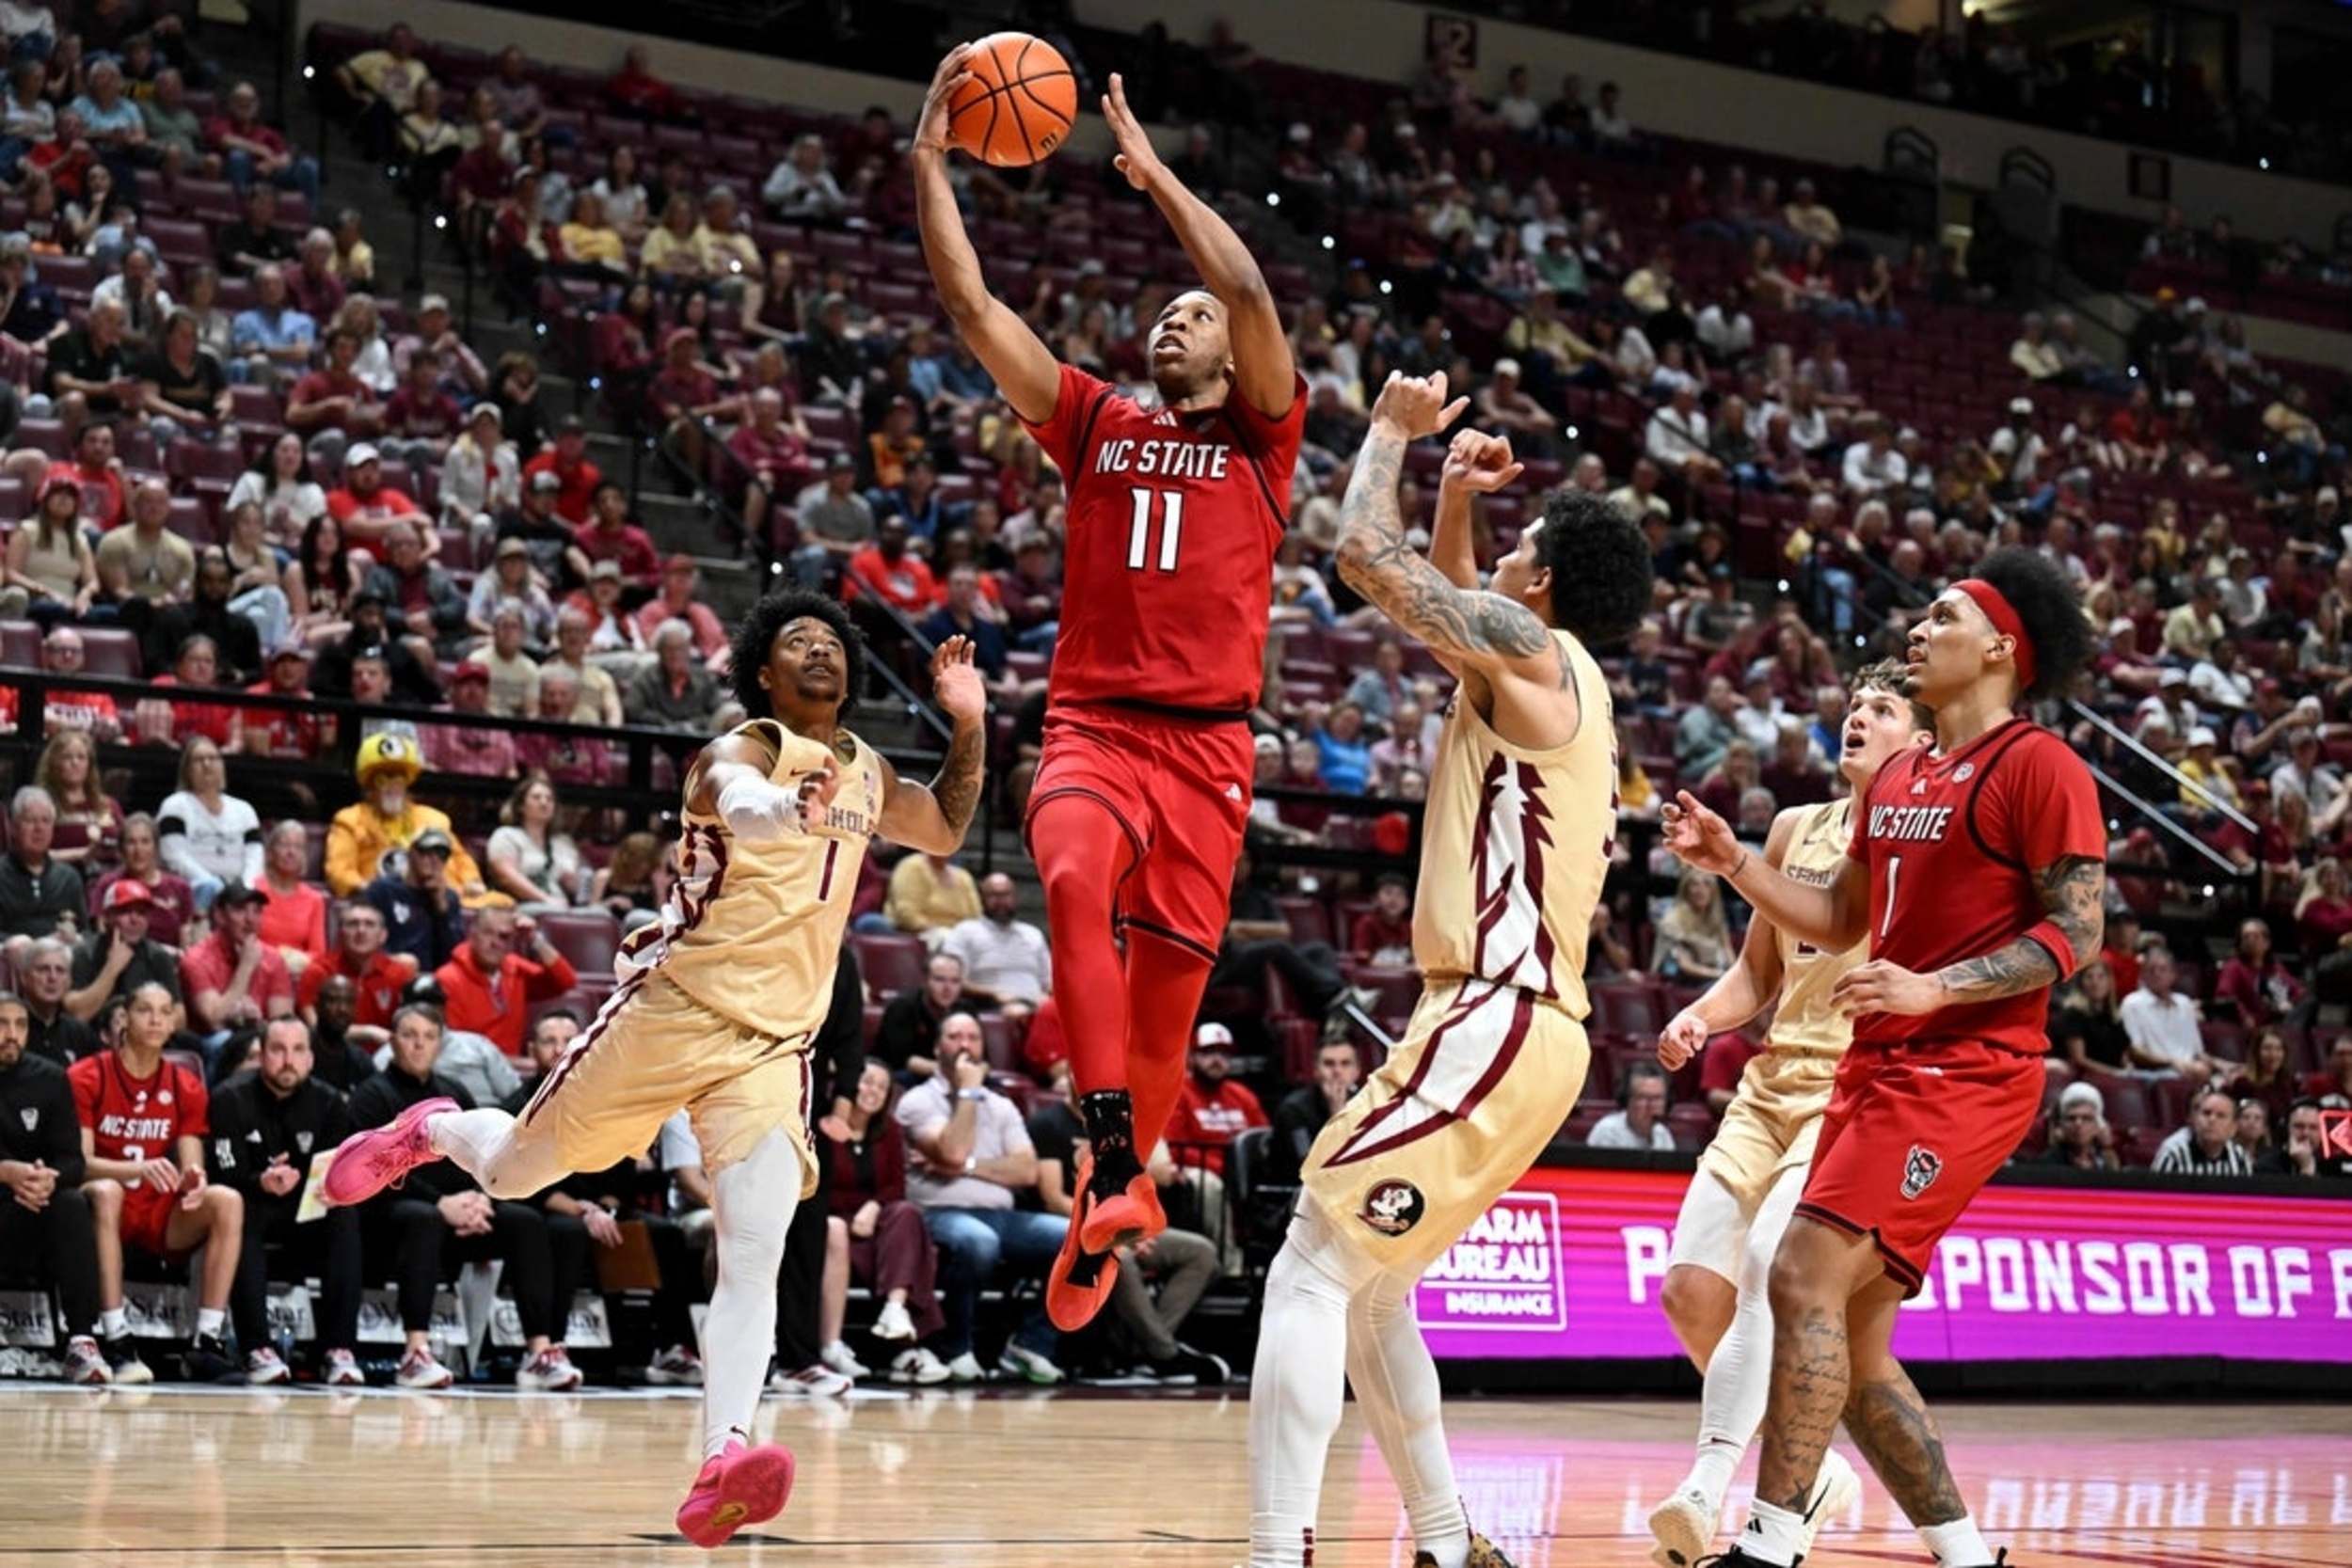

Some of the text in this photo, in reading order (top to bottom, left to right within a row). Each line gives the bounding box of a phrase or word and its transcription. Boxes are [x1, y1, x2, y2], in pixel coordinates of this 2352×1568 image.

[1096, 440, 1230, 478] NC STATE
[1128, 488, 1183, 571] 11
[1887, 805, 1954, 840] STATE
[818, 839, 839, 903] 1
[1881, 856, 1901, 939] 1
[99, 1115, 172, 1140] NC STATE
[1457, 1208, 1547, 1243] ARM
[2228, 1244, 2312, 1319] OF
[1445, 1291, 1553, 1317] INSURANCE
